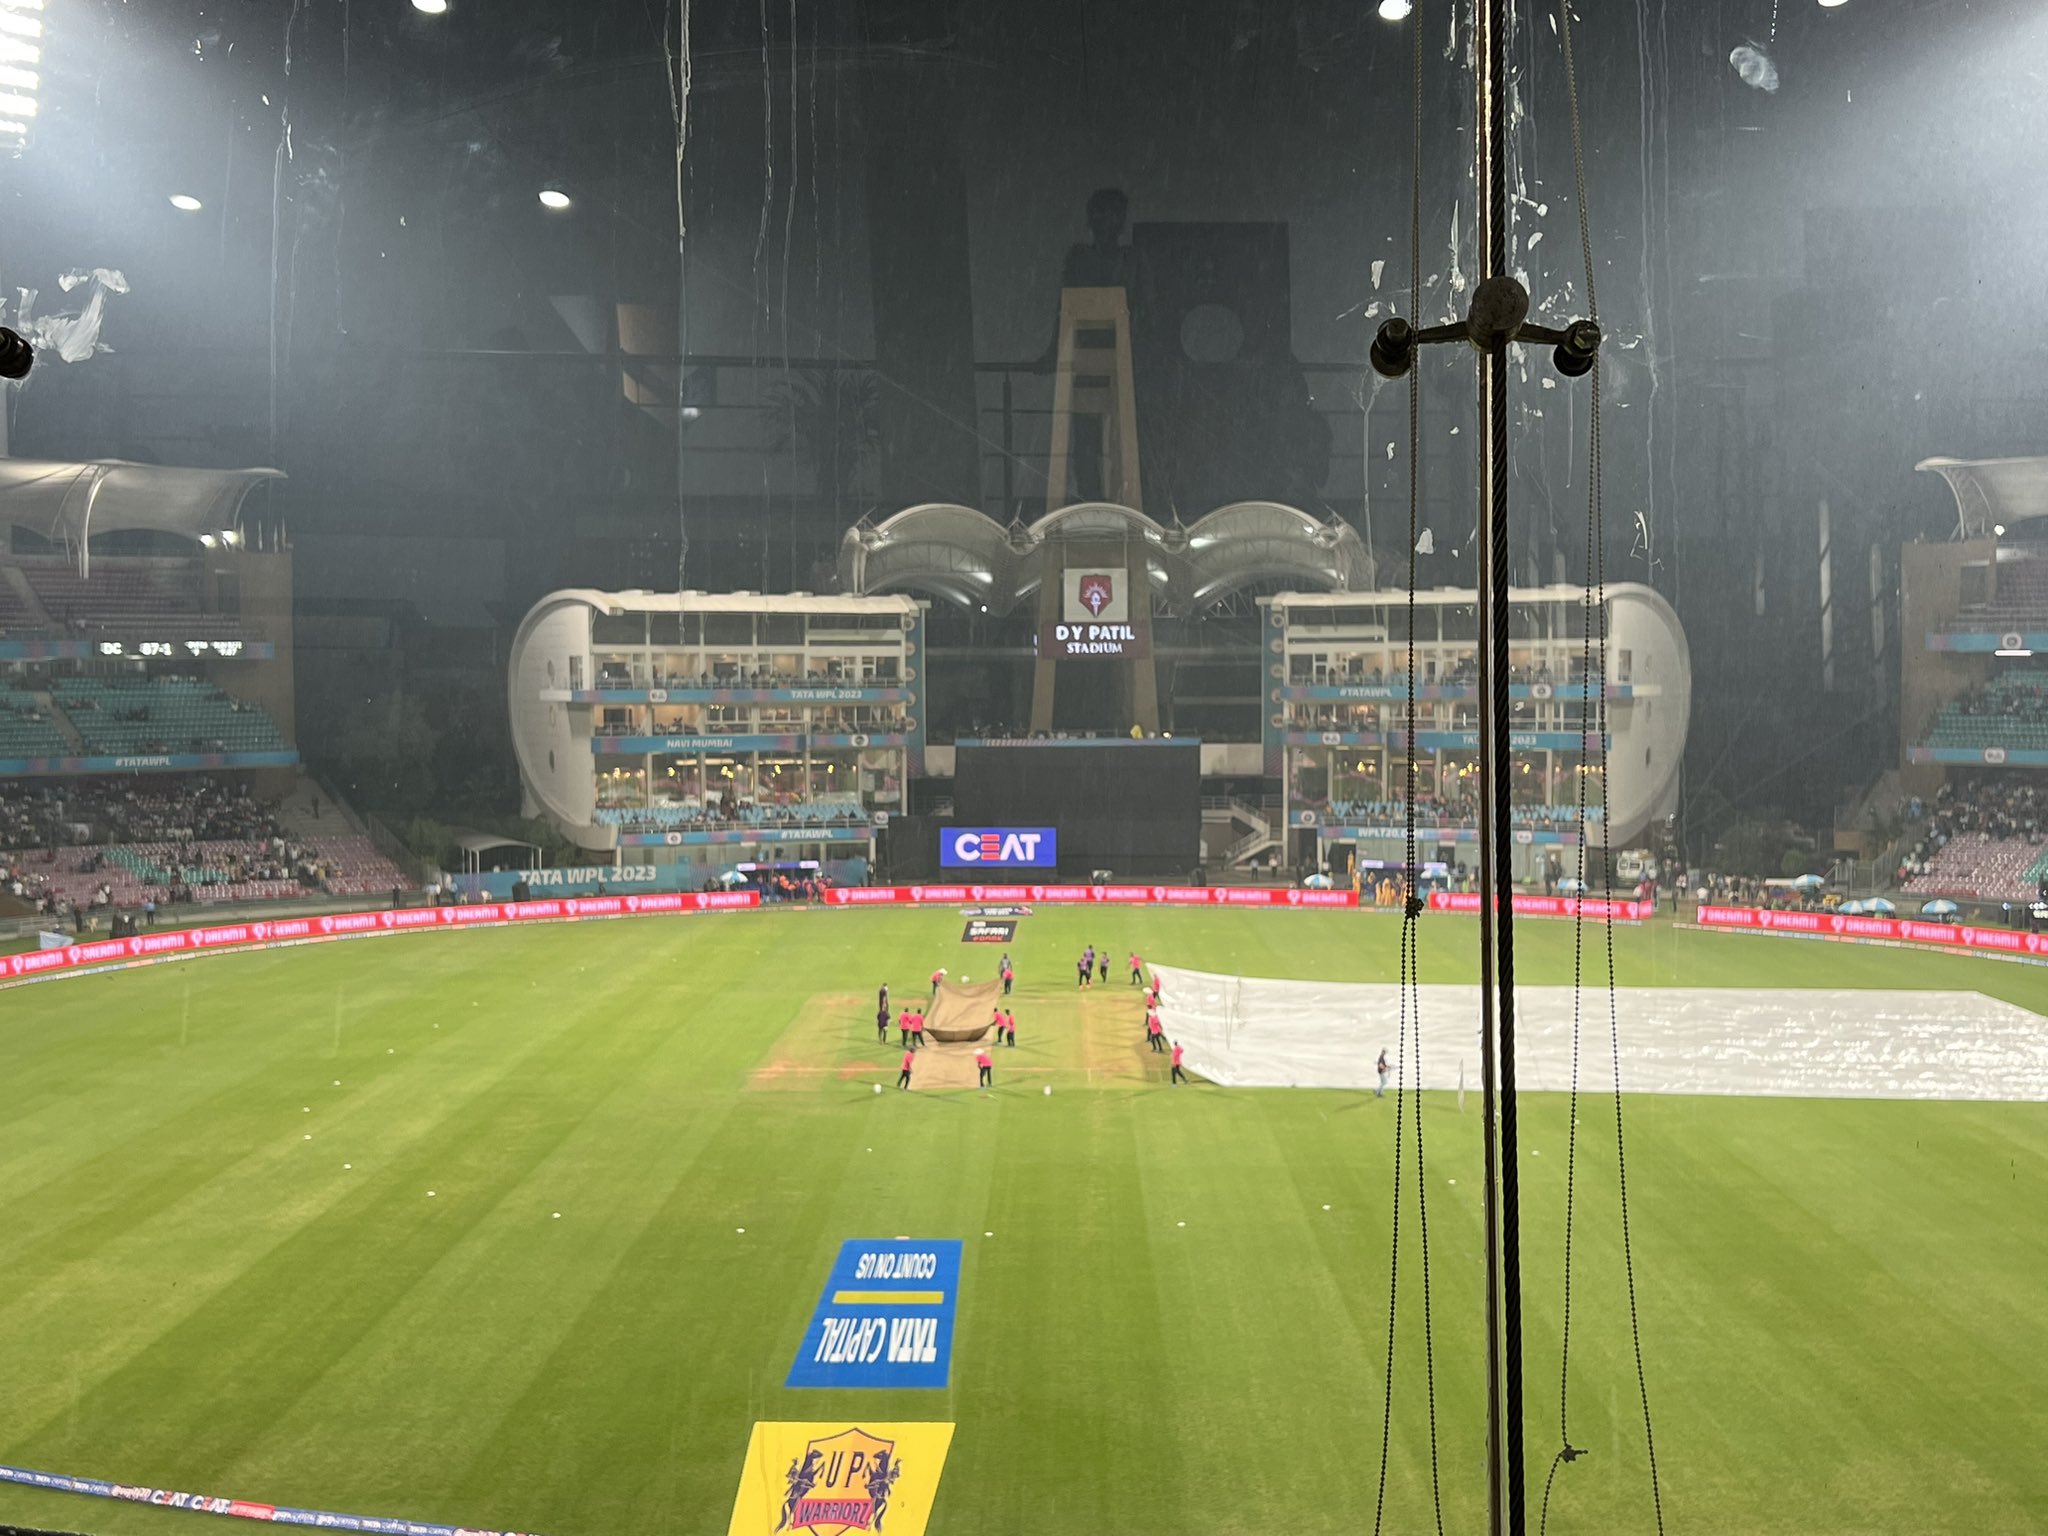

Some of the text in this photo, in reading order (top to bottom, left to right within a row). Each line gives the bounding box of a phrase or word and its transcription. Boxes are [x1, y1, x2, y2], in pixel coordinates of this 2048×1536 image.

[1088, 625, 1136, 641] PATIL
[100, 642, 122, 655] DC
[1066, 642, 1123, 654] STADIUM
[791, 689, 863, 699] TATA WPL 2023
[667, 738, 733, 749] NAVI MUMBAI
[115, 756, 172, 767] #TATAWPL
[781, 828, 834, 840] #TATAWPL
[954, 832, 1042, 862] CEAT
[518, 865, 657, 886] TATA WPL 2023
[969, 927, 1009, 936] SAFARI
[855, 1253, 937, 1279] COUNT ON US
[813, 1317, 938, 1363] TATA CAPITAL
[151, 1489, 189, 1507] CEAT
[190, 1495, 231, 1514] CEAT
[800, 1502, 870, 1524] WARRIORZ
